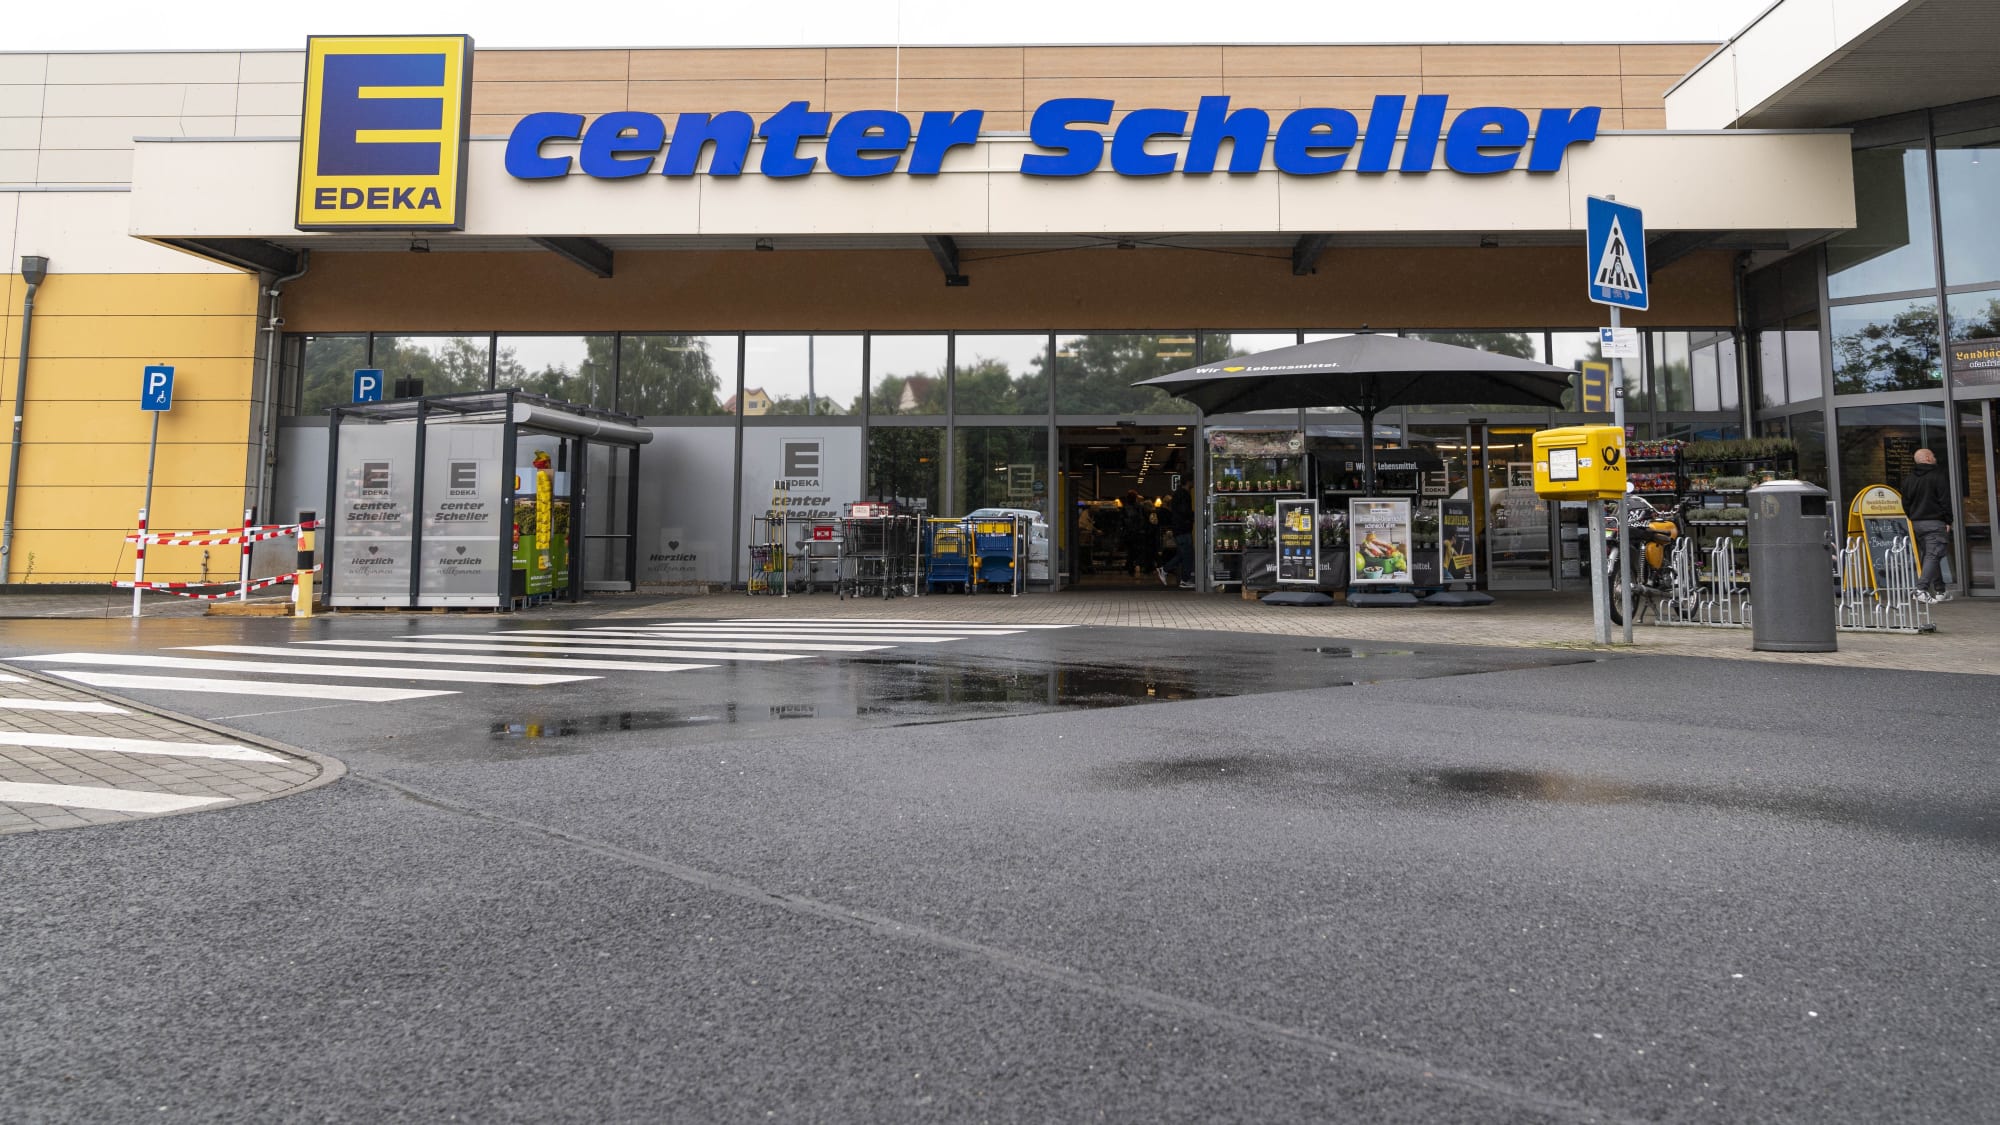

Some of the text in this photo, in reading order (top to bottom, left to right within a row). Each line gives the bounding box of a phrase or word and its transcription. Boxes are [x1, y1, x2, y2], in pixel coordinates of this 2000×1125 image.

[504, 94, 1602, 180] center Scheller
[314, 186, 443, 210] EDEKA
[1246, 362, 1341, 372] Lebensmittel.
[149, 372, 167, 395] P
[359, 376, 376, 399] P
[785, 479, 820, 487] DEKA
[353, 502, 397, 510] center
[440, 502, 484, 510] center
[347, 512, 401, 521] Scheller
[434, 512, 489, 521] Scheller
[440, 557, 482, 565] Herzlich
[649, 553, 697, 561] Herzlich
